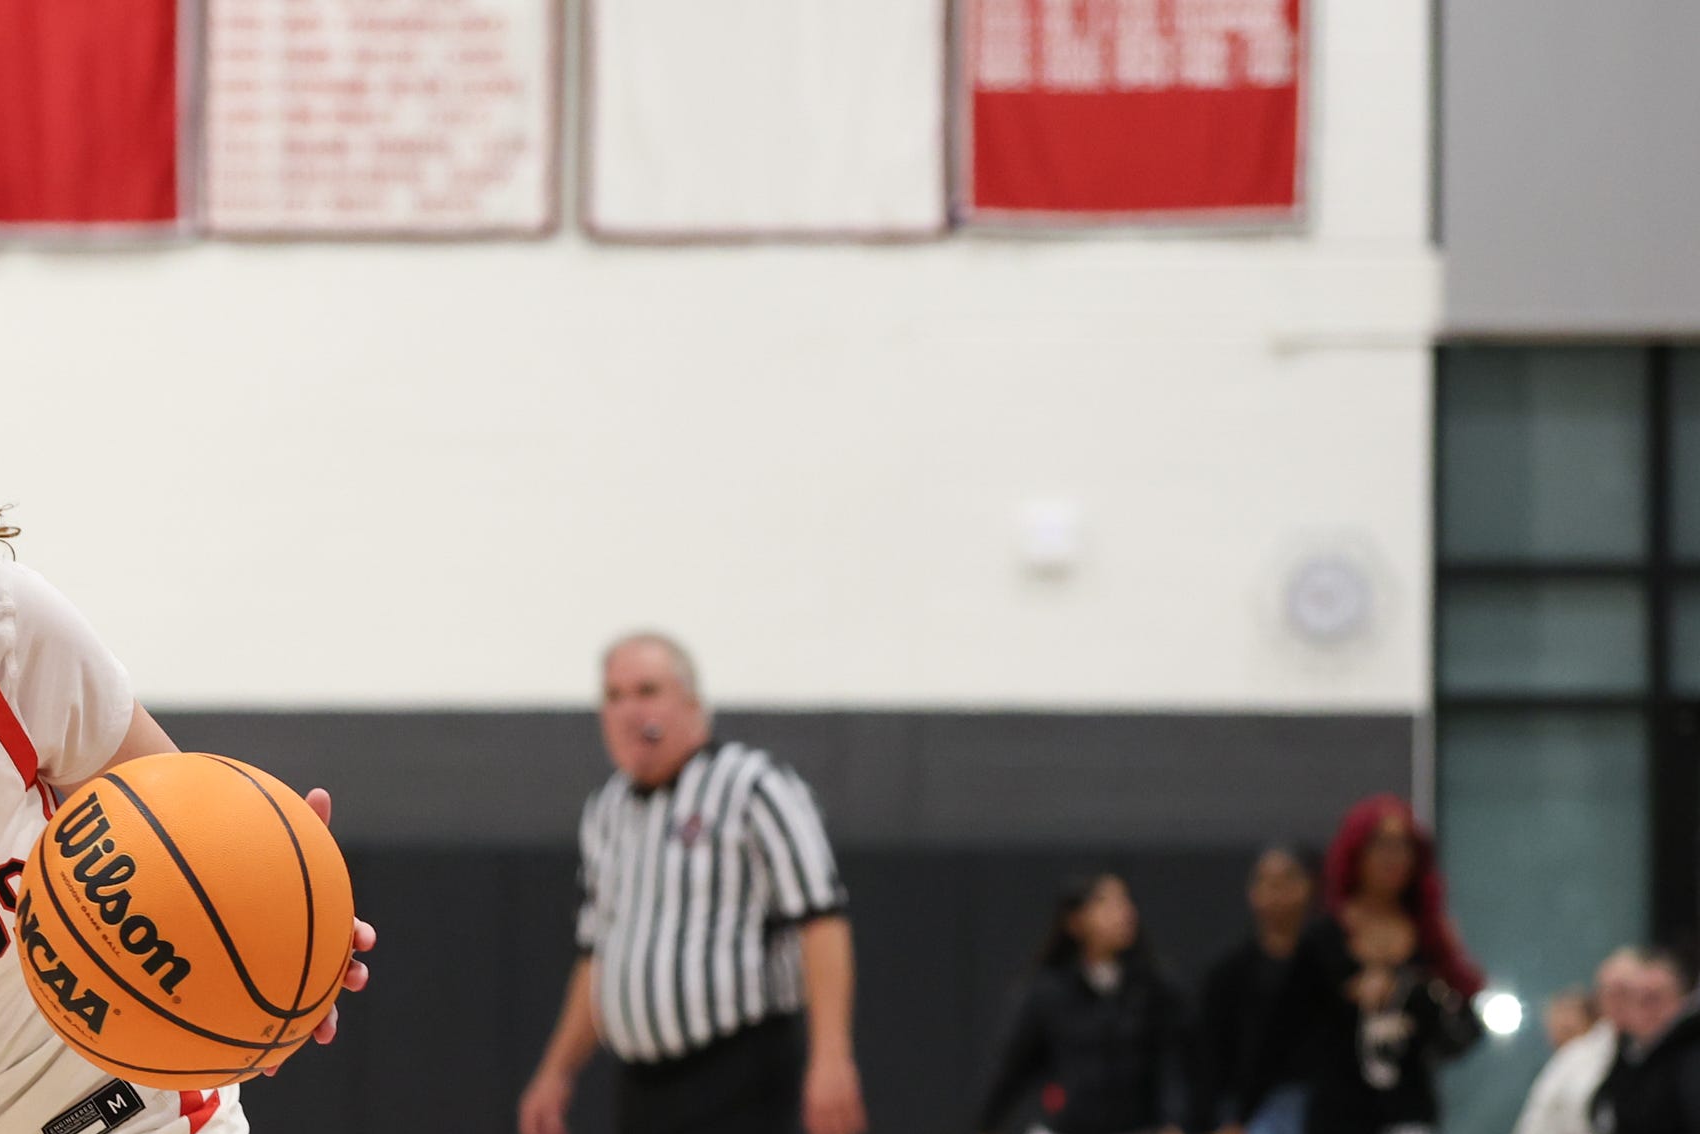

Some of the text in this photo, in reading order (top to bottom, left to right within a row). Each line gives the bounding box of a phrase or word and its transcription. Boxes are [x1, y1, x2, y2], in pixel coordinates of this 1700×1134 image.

[55, 791, 191, 996] Wilson
[80, 904, 102, 932] GAME
[101, 932, 122, 958] BALL
[17, 889, 110, 1035] NCAA
[106, 1093, 128, 1115] M
